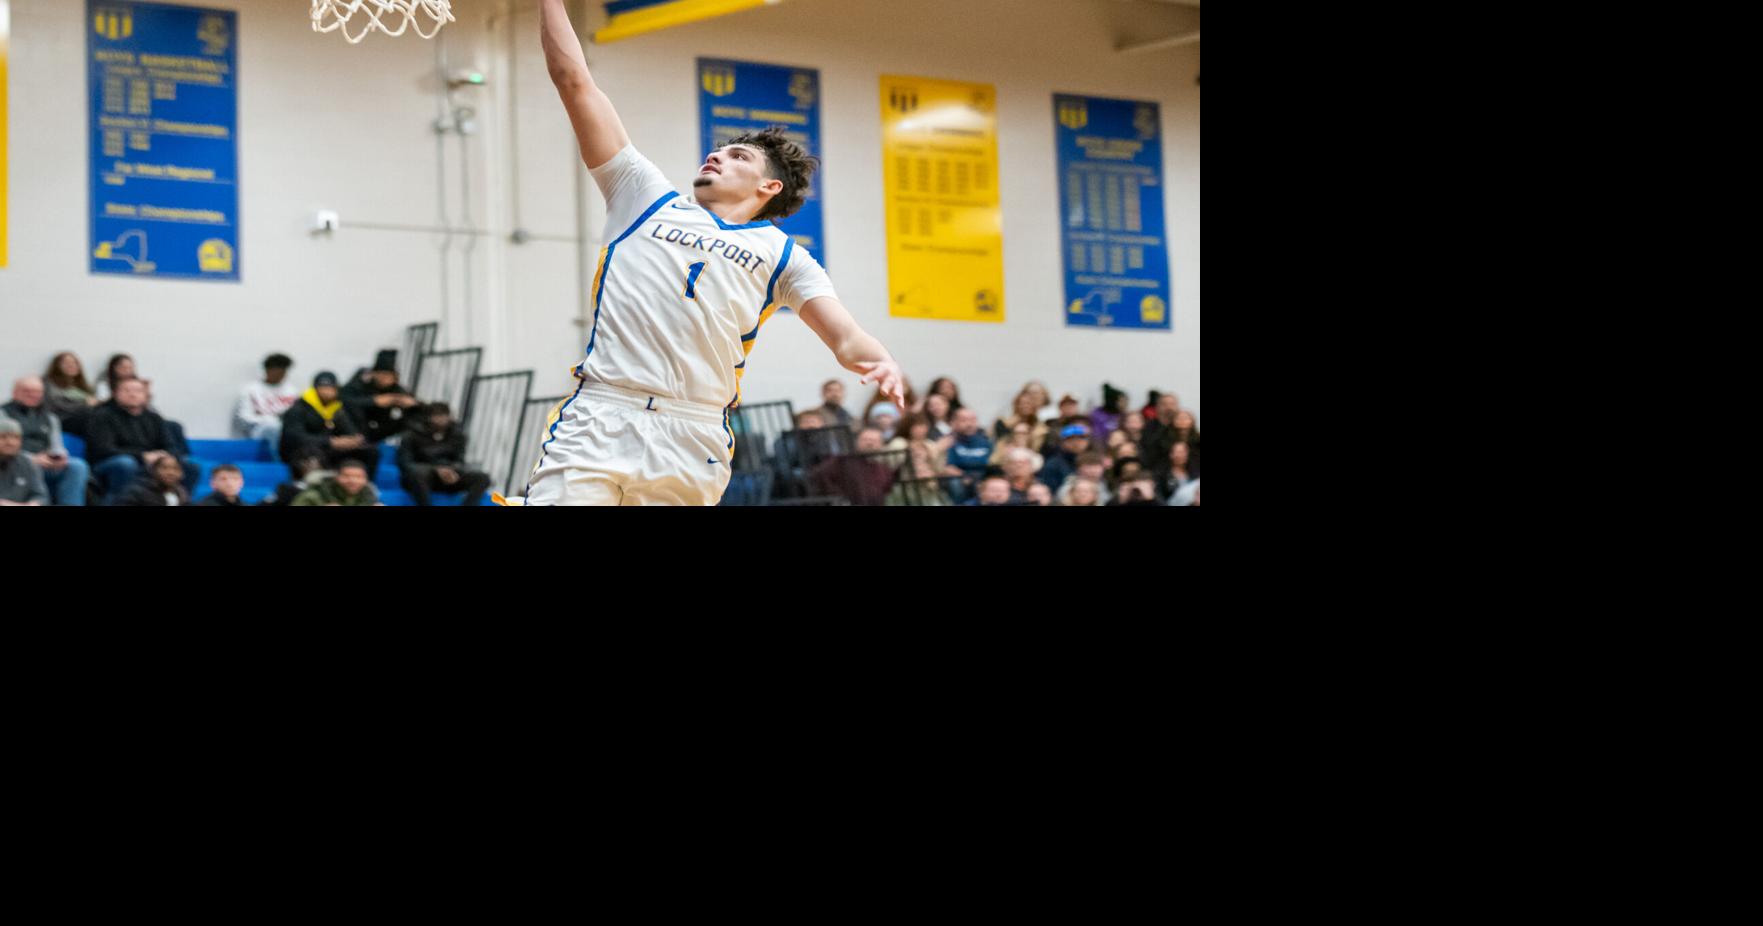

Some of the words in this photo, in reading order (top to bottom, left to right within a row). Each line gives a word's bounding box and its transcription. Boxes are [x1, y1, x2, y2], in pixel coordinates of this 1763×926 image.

[651, 223, 766, 273] LOCKPORT
[681, 260, 708, 301] 1
[646, 396, 657, 412] L
